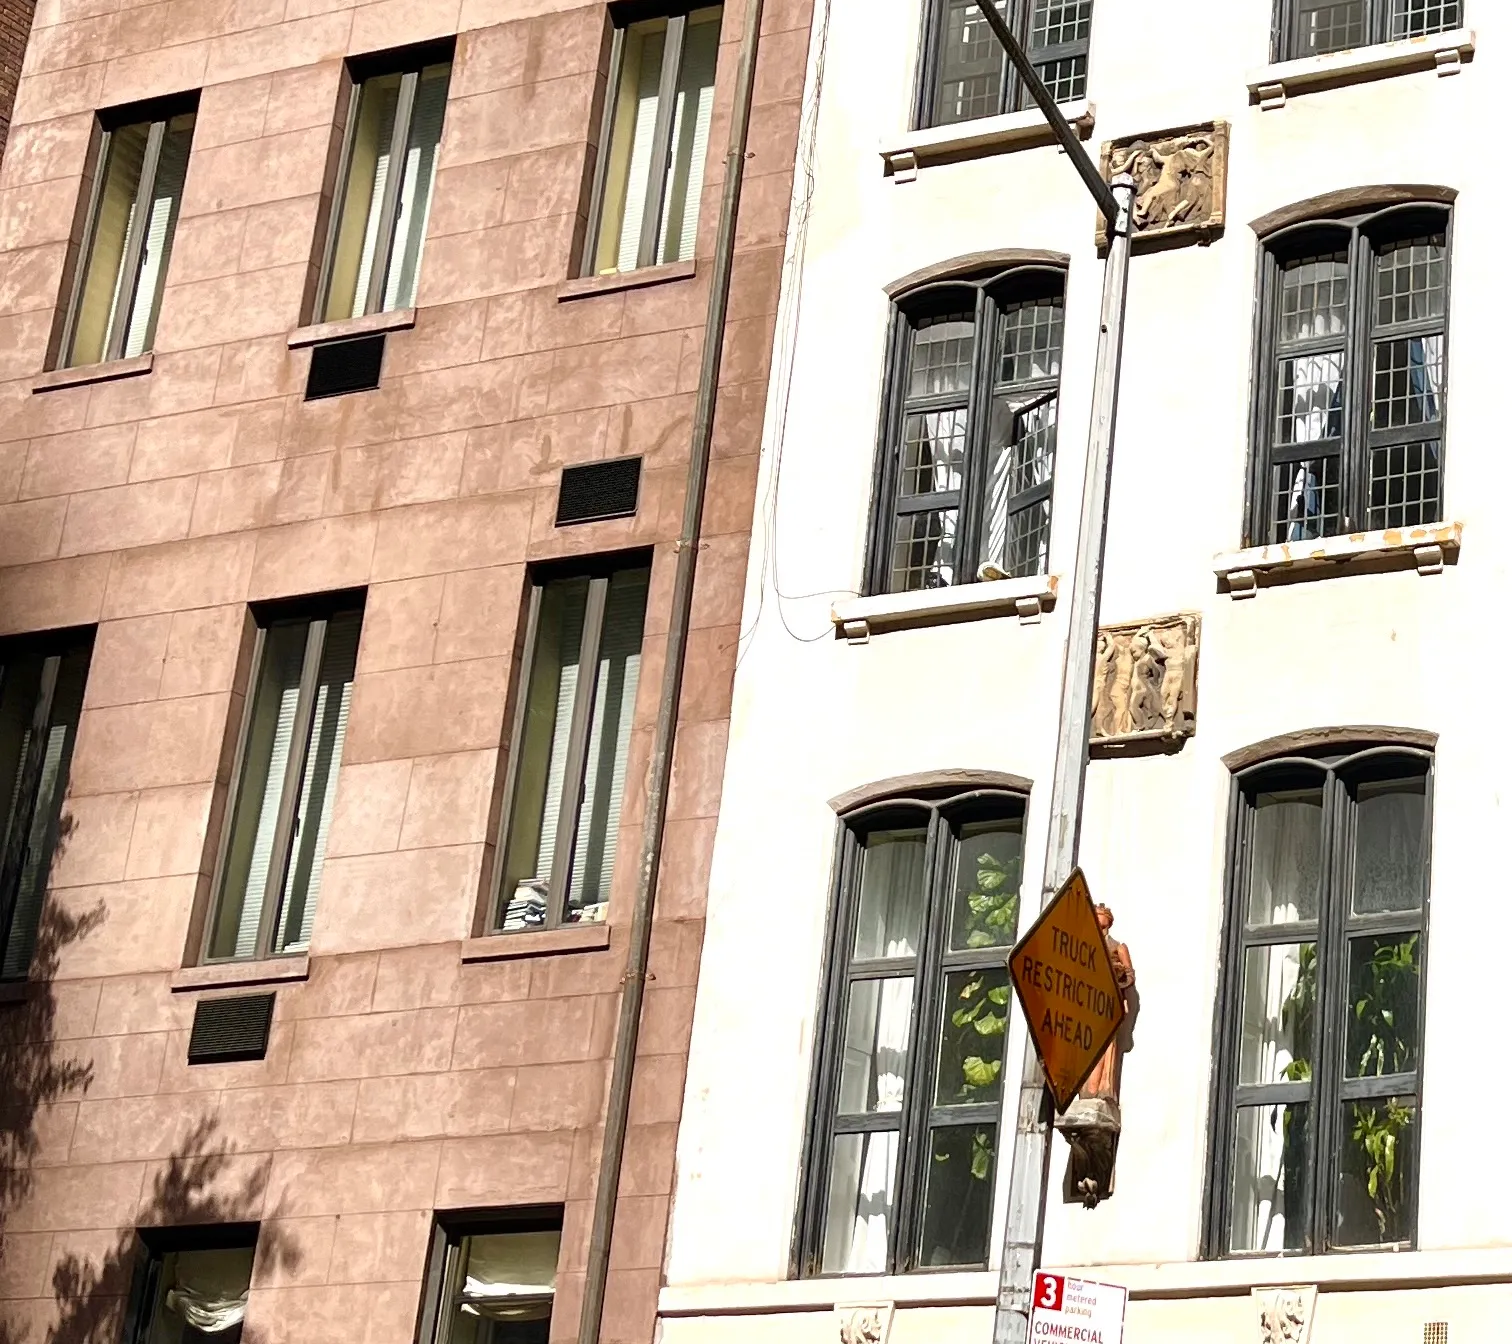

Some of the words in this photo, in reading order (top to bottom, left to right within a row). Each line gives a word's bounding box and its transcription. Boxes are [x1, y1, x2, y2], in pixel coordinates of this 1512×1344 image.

[1051, 925, 1097, 972] TRUCK
[1022, 955, 1115, 1021] RESTRICTION
[1041, 1007, 1093, 1051] AHEAD
[1040, 1276, 1057, 1307] 3
[1066, 1294, 1097, 1306] metered
[1064, 1306, 1092, 1318] parking
[1034, 1320, 1104, 1344] COMMERCIAL
